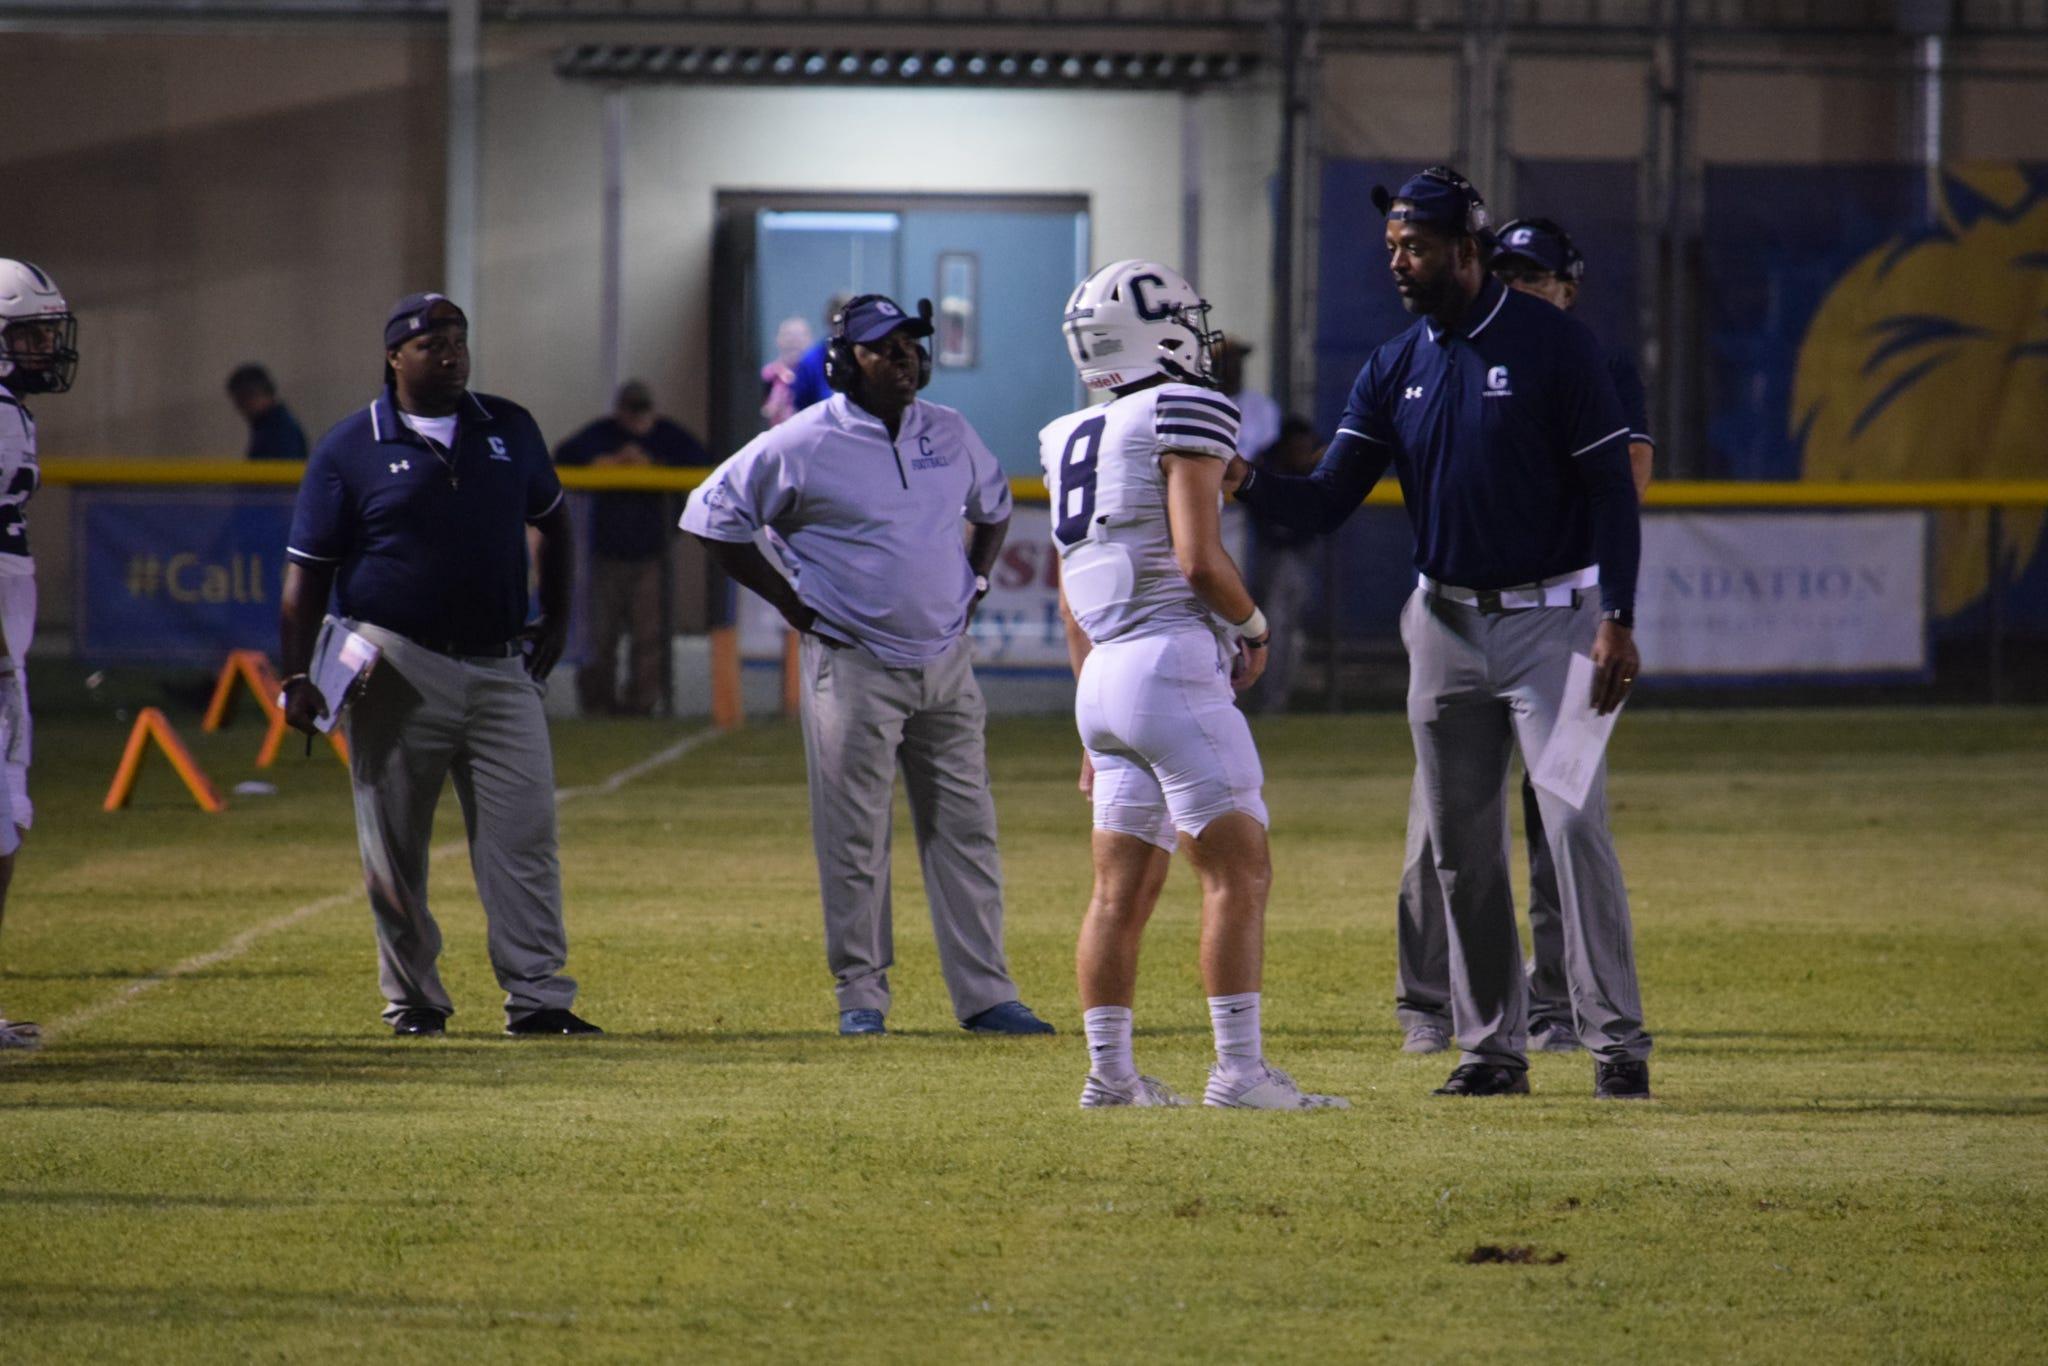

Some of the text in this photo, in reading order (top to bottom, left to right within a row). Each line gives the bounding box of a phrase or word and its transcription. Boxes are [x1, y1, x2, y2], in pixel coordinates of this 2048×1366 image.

[1130, 273, 1176, 321] C
[919, 436, 934, 456] C
[1055, 414, 1106, 546] 8
[127, 552, 265, 604] #Call
